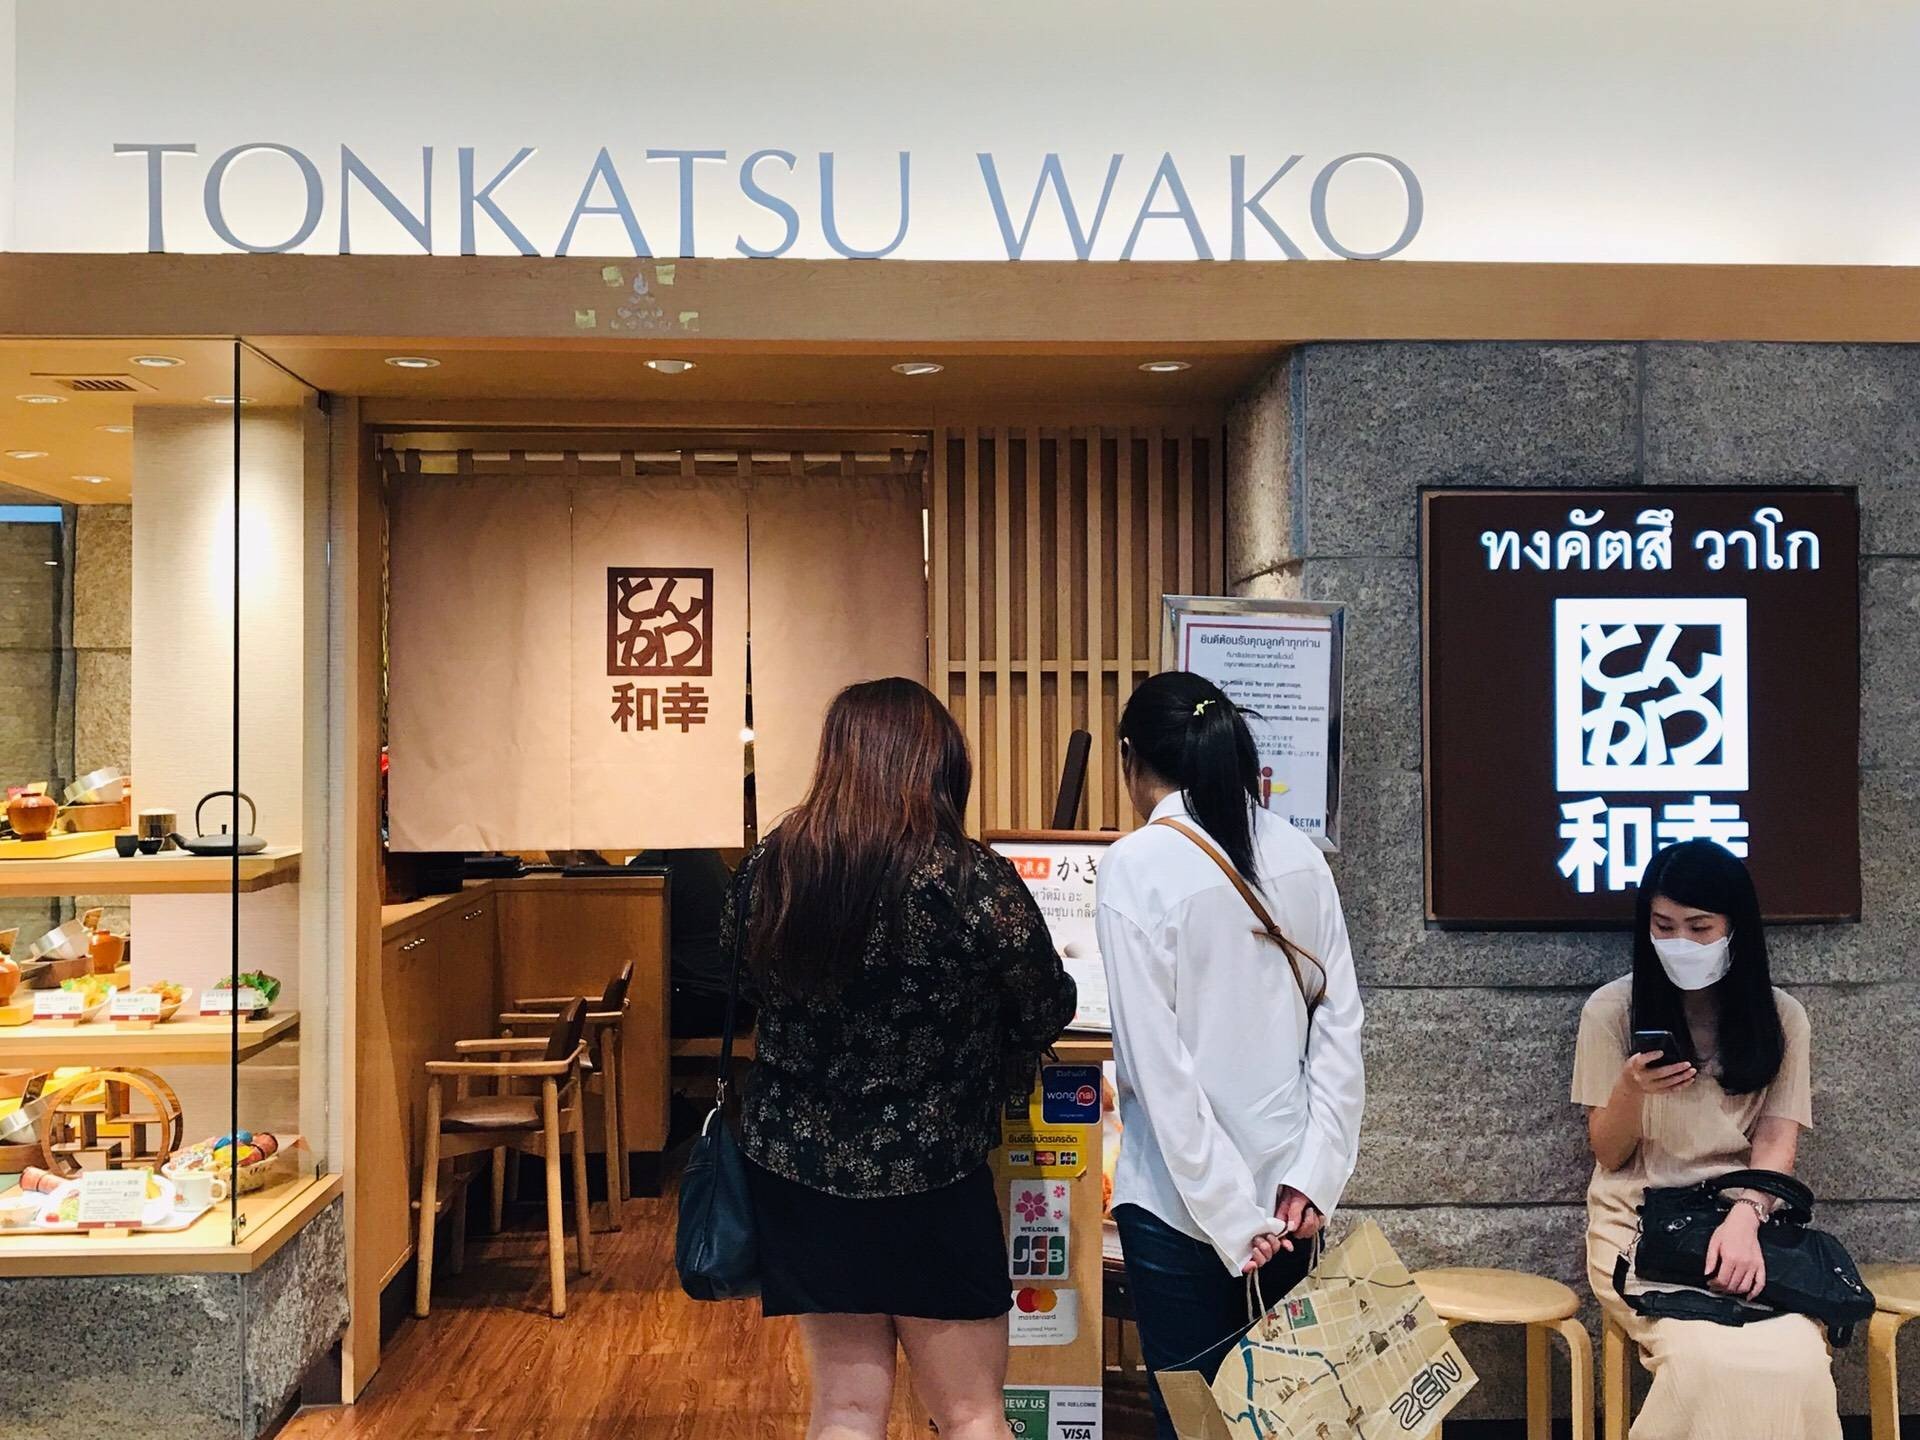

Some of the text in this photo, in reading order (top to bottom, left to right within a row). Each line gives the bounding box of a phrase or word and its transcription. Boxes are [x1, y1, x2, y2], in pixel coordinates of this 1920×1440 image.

[113, 143, 1424, 261] TONKATSU WAKO
[1695, 507, 1821, 571] วาโก
[610, 682, 709, 733] 和幸
[1013, 1248, 1064, 1263] JCB
[1030, 1399, 1046, 1409] US
[1389, 1351, 1462, 1431] ZEN
[1061, 1428, 1091, 1440] VISA
